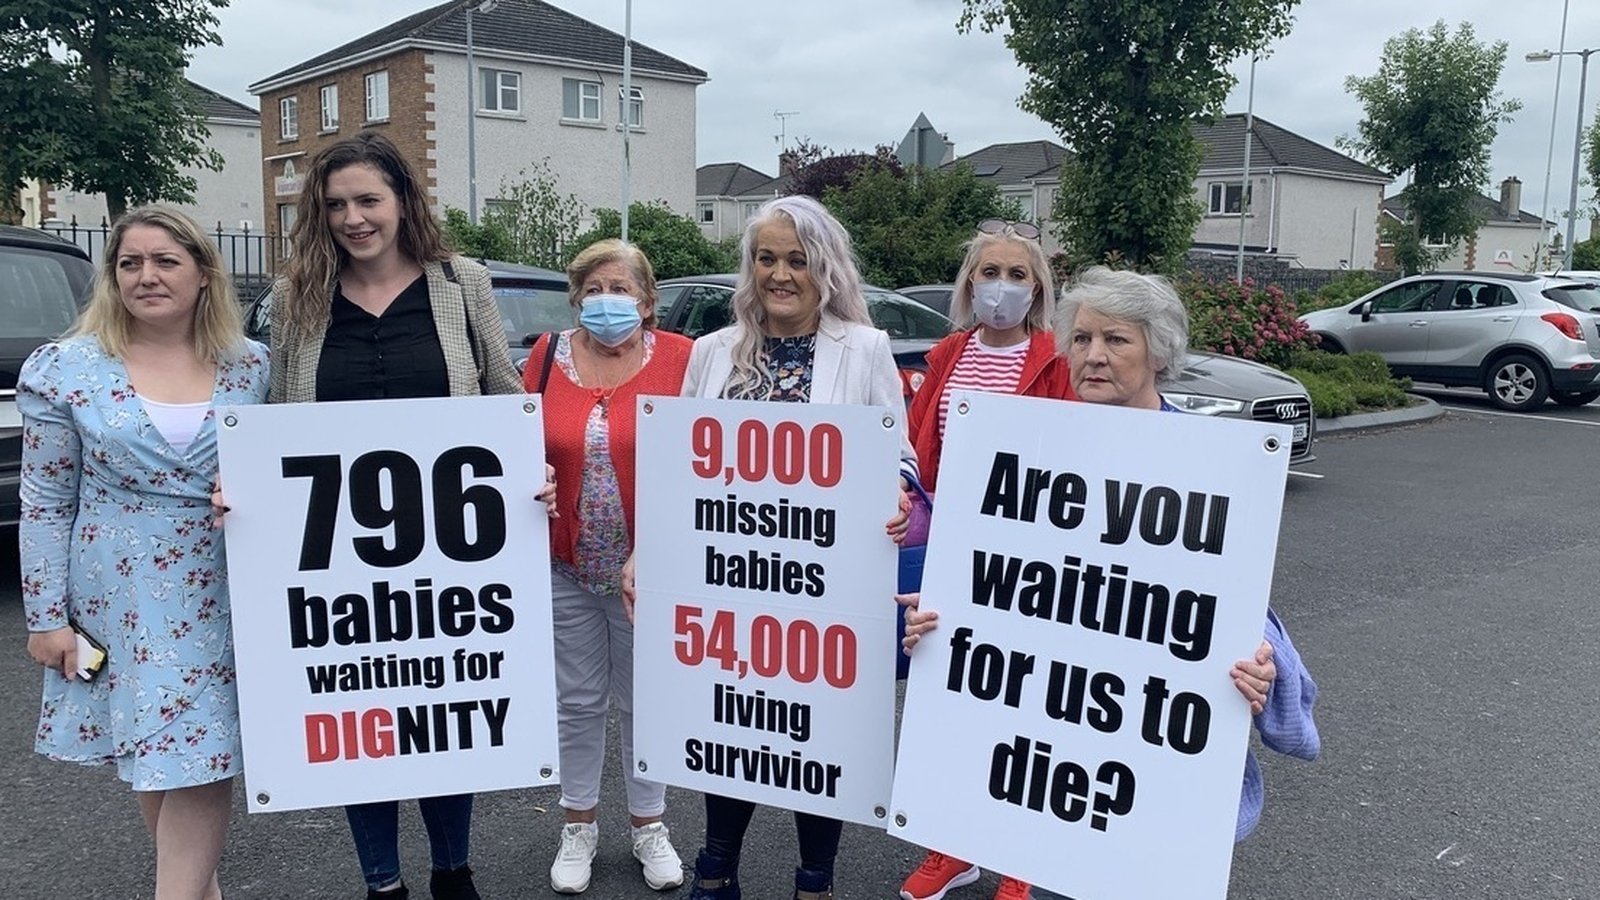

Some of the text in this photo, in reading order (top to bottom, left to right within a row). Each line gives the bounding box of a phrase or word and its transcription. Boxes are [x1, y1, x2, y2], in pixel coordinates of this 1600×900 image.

[691, 416, 843, 487] 9,000
[282, 446, 506, 571] 796
[695, 494, 836, 548] missing
[979, 451, 1230, 555] Are you
[706, 546, 825, 598] babies
[972, 550, 1217, 662] waiting
[288, 579, 515, 648] babies
[675, 605, 856, 688] 54,000
[306, 648, 504, 694] waiting for
[947, 626, 1211, 754] for us to
[304, 697, 510, 764] DIGNITY
[714, 683, 811, 742] living
[685, 738, 842, 798] survivior
[988, 735, 1136, 832] die?
